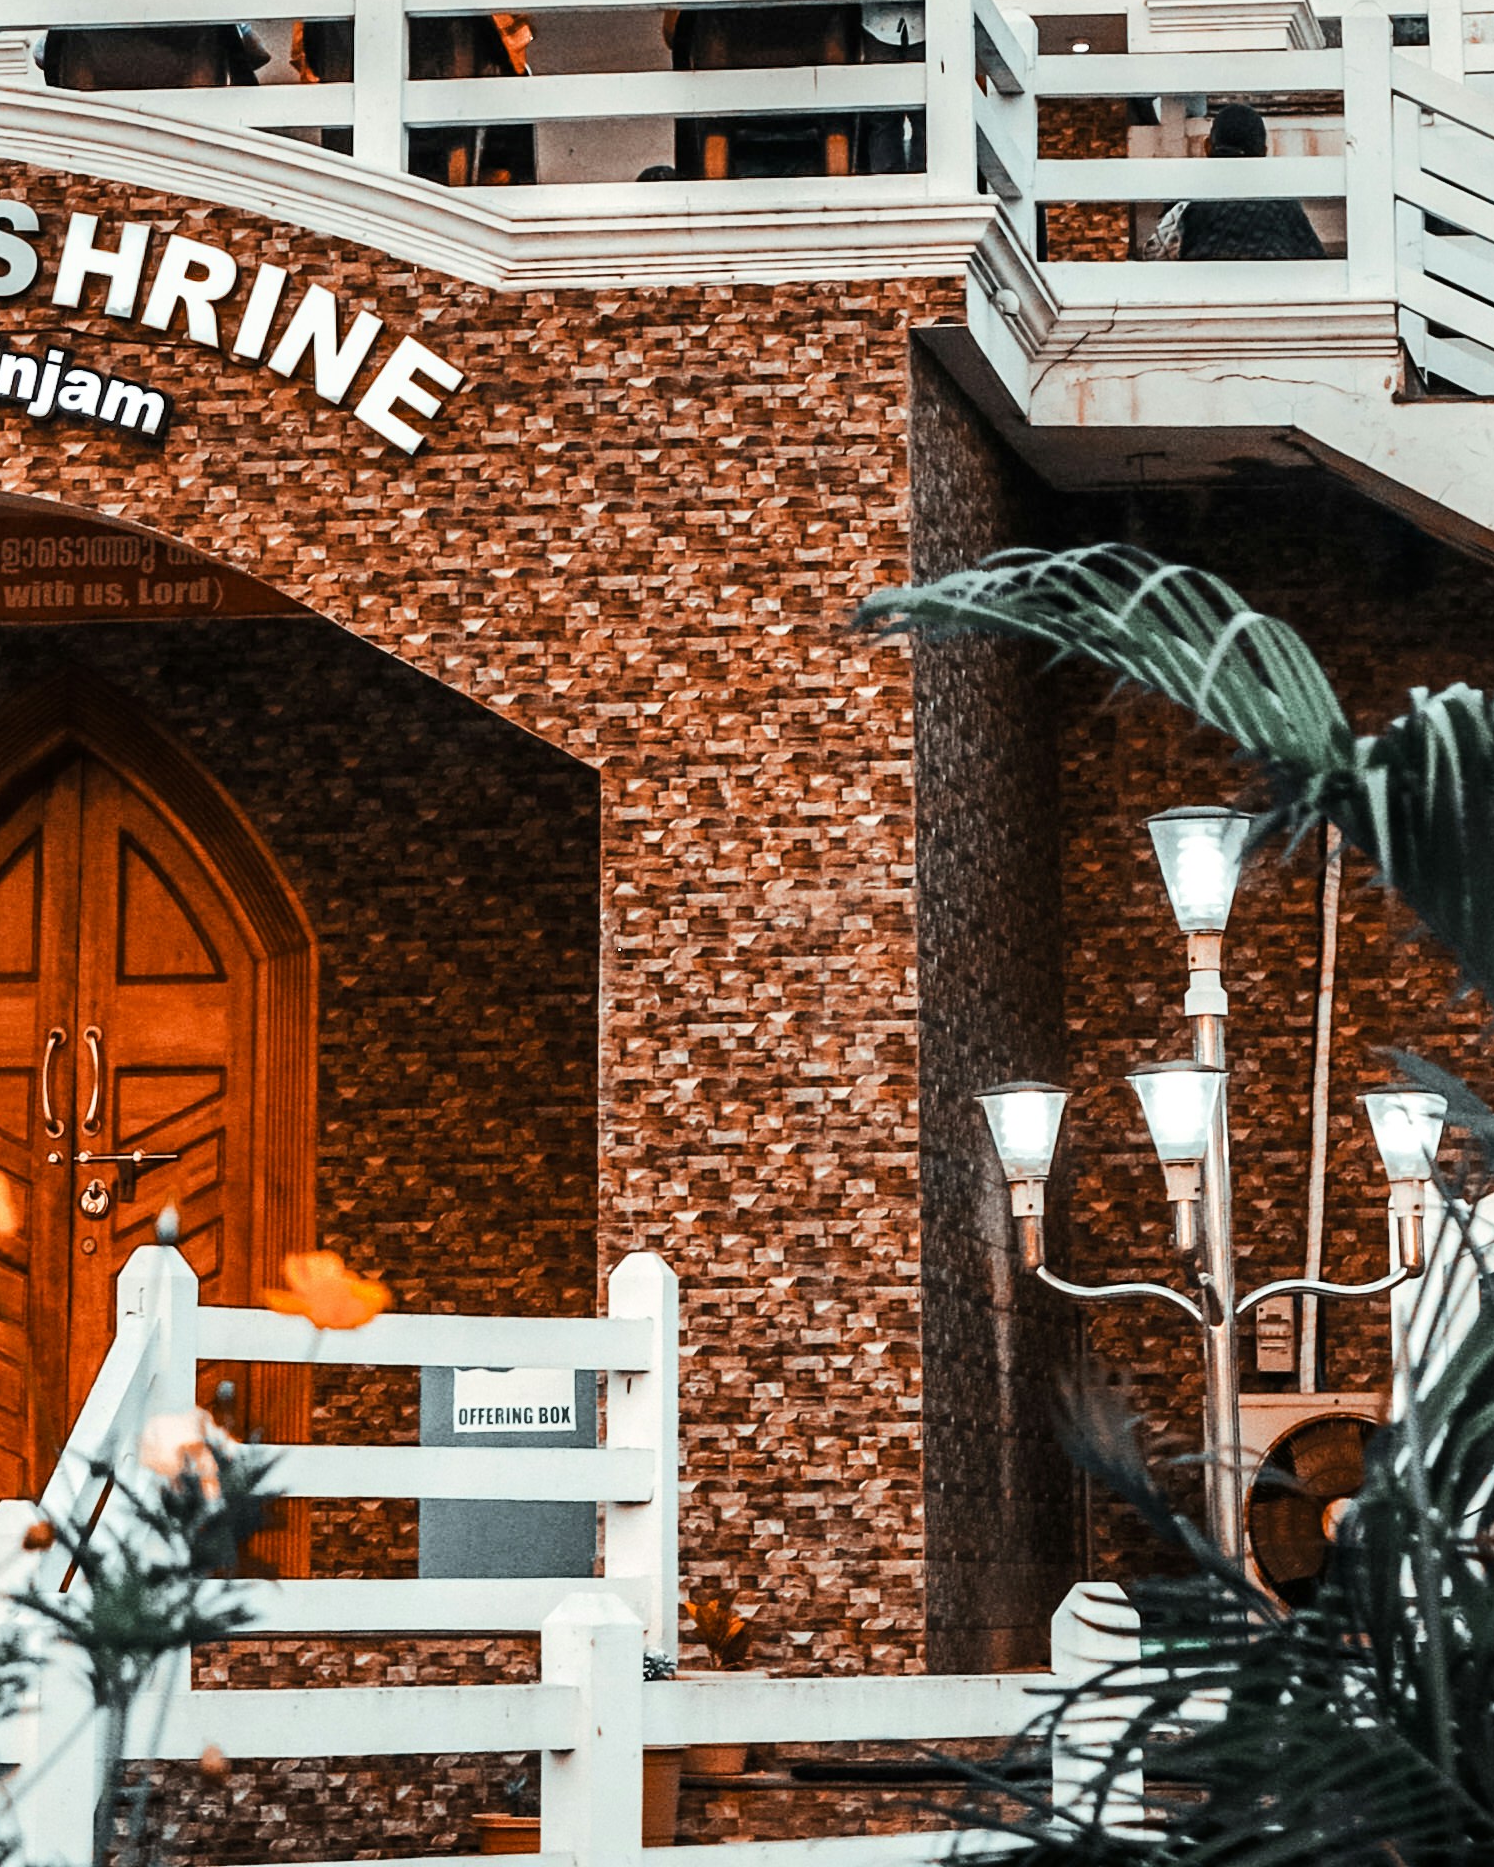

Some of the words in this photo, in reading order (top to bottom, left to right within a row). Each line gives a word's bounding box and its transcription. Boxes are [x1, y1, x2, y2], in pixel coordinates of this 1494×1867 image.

[4, 579, 75, 608] with
[83, 582, 129, 608] us,
[458, 1407, 533, 1425] OFFERING
[539, 1406, 570, 1424] BOX
